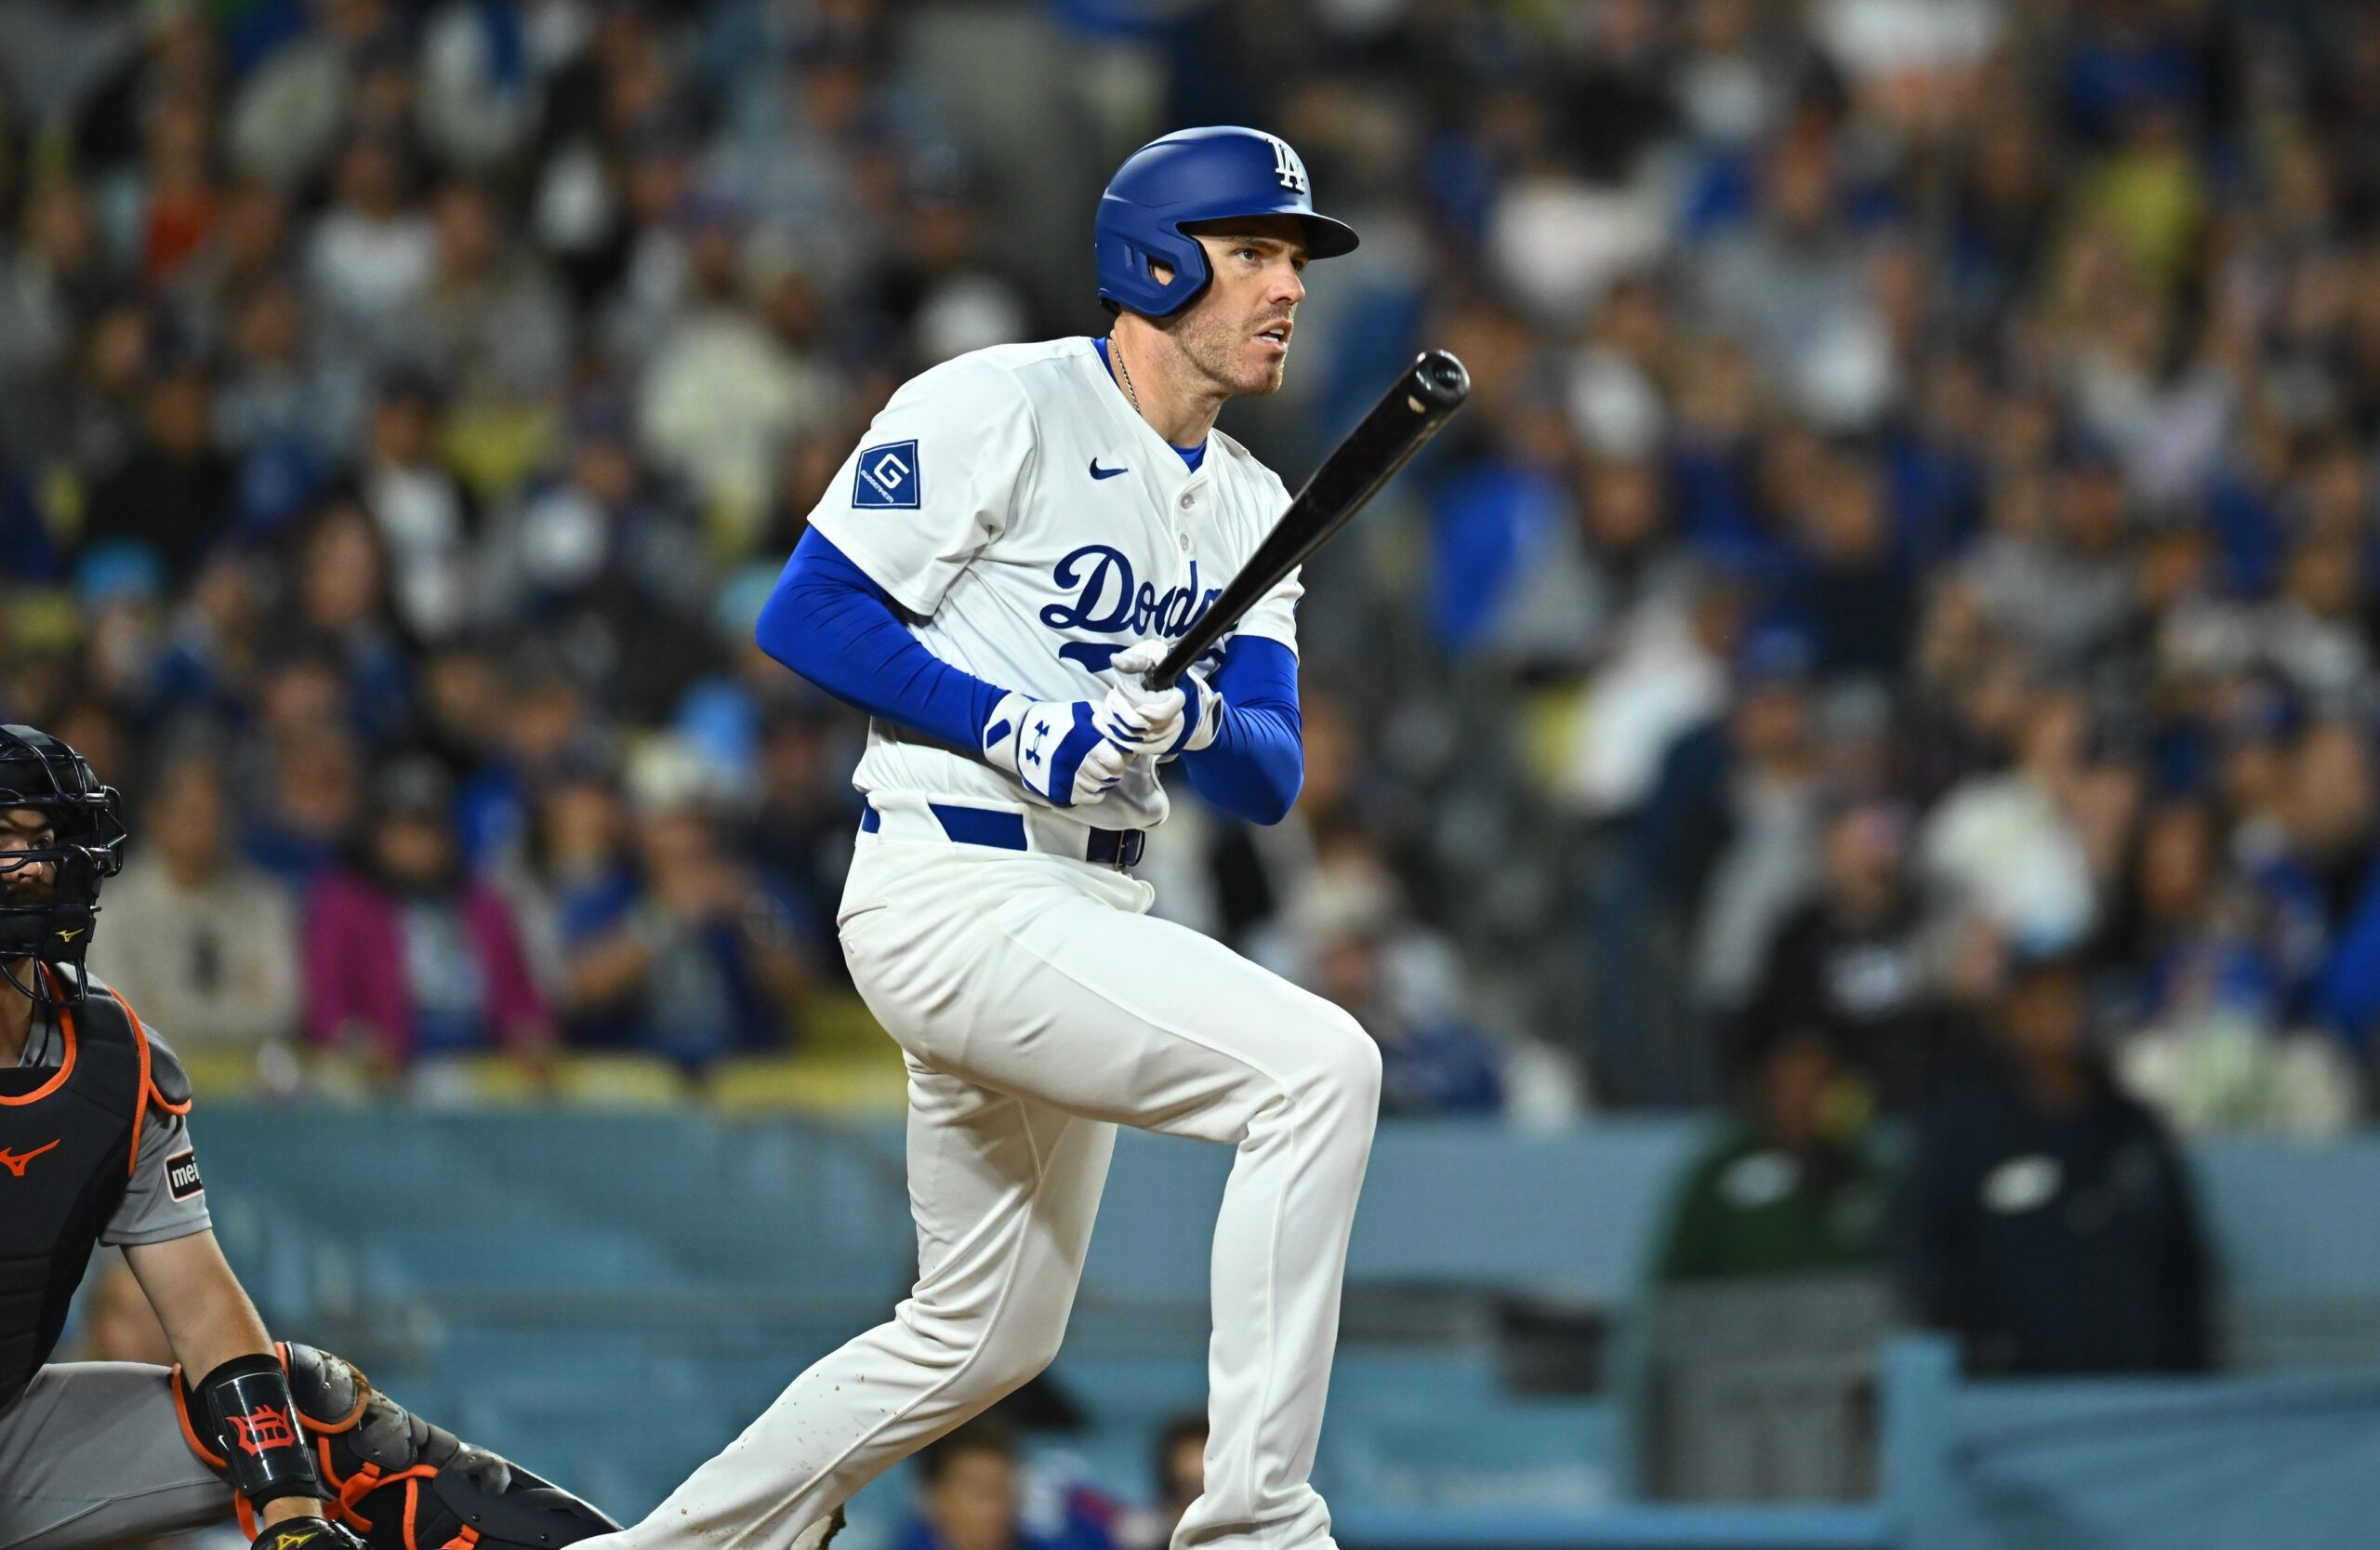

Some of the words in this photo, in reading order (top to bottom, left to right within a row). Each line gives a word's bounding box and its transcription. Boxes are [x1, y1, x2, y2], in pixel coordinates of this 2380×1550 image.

[1267, 138, 1305, 194] LA
[874, 453, 910, 489] G
[171, 1155, 202, 1188] mei
